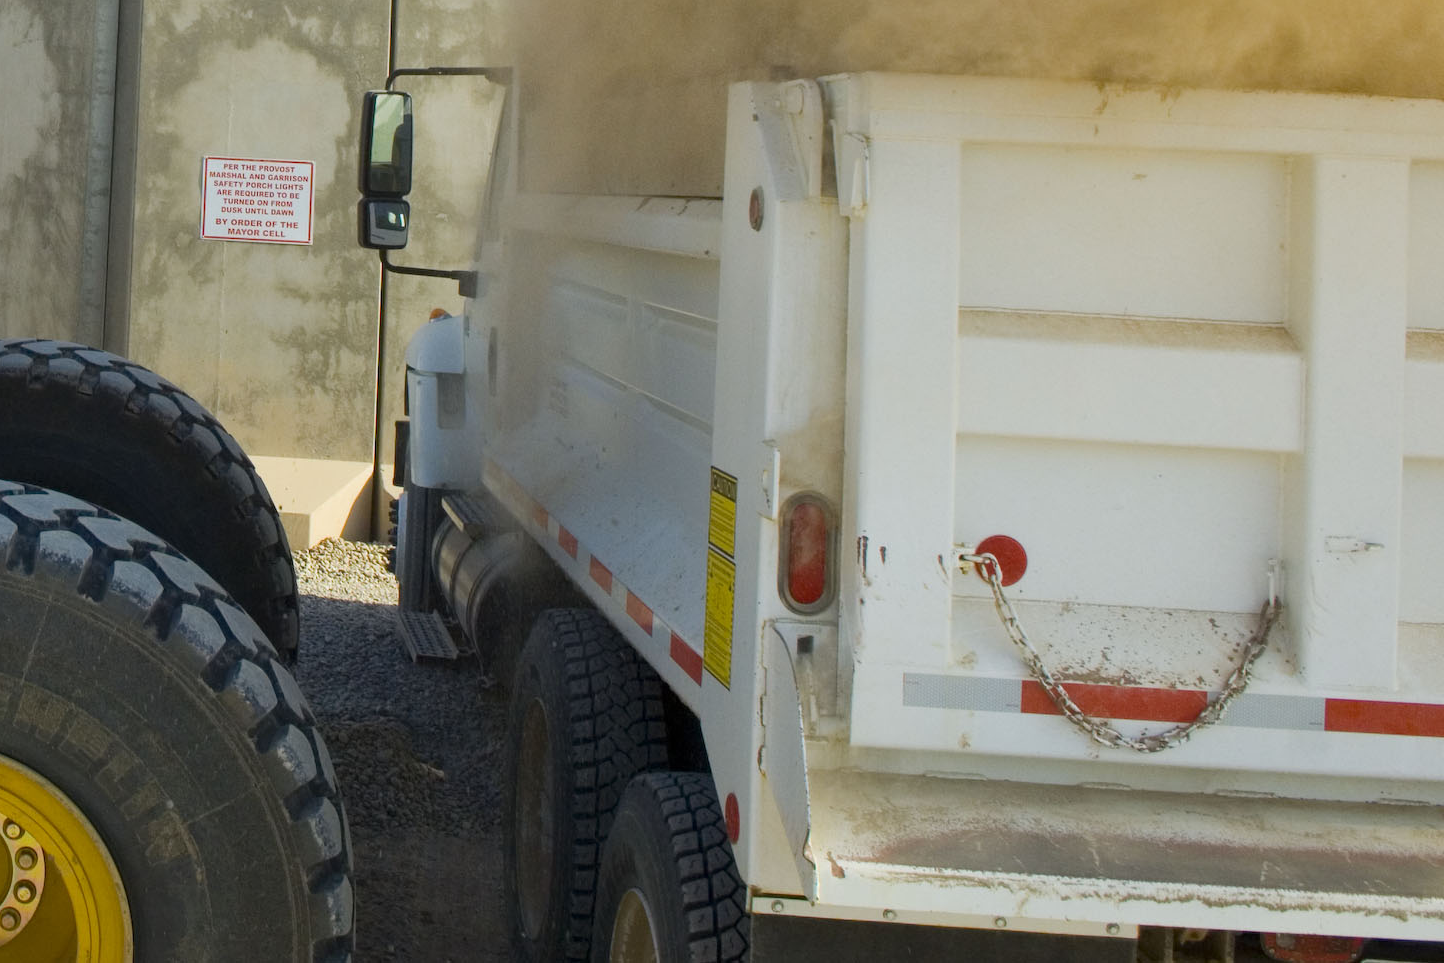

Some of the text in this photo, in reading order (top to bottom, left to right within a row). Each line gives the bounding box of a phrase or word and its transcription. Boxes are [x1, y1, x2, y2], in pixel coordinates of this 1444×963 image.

[259, 165, 295, 173] PROVOST
[209, 171, 246, 179] MARSHAL
[268, 174, 308, 182] GARRISON
[214, 180, 243, 188] SAFETY
[234, 190, 274, 198] REQUIRED
[231, 219, 262, 227] ORDER
[280, 221, 298, 229] THE
[228, 228, 260, 236] MAYOR
